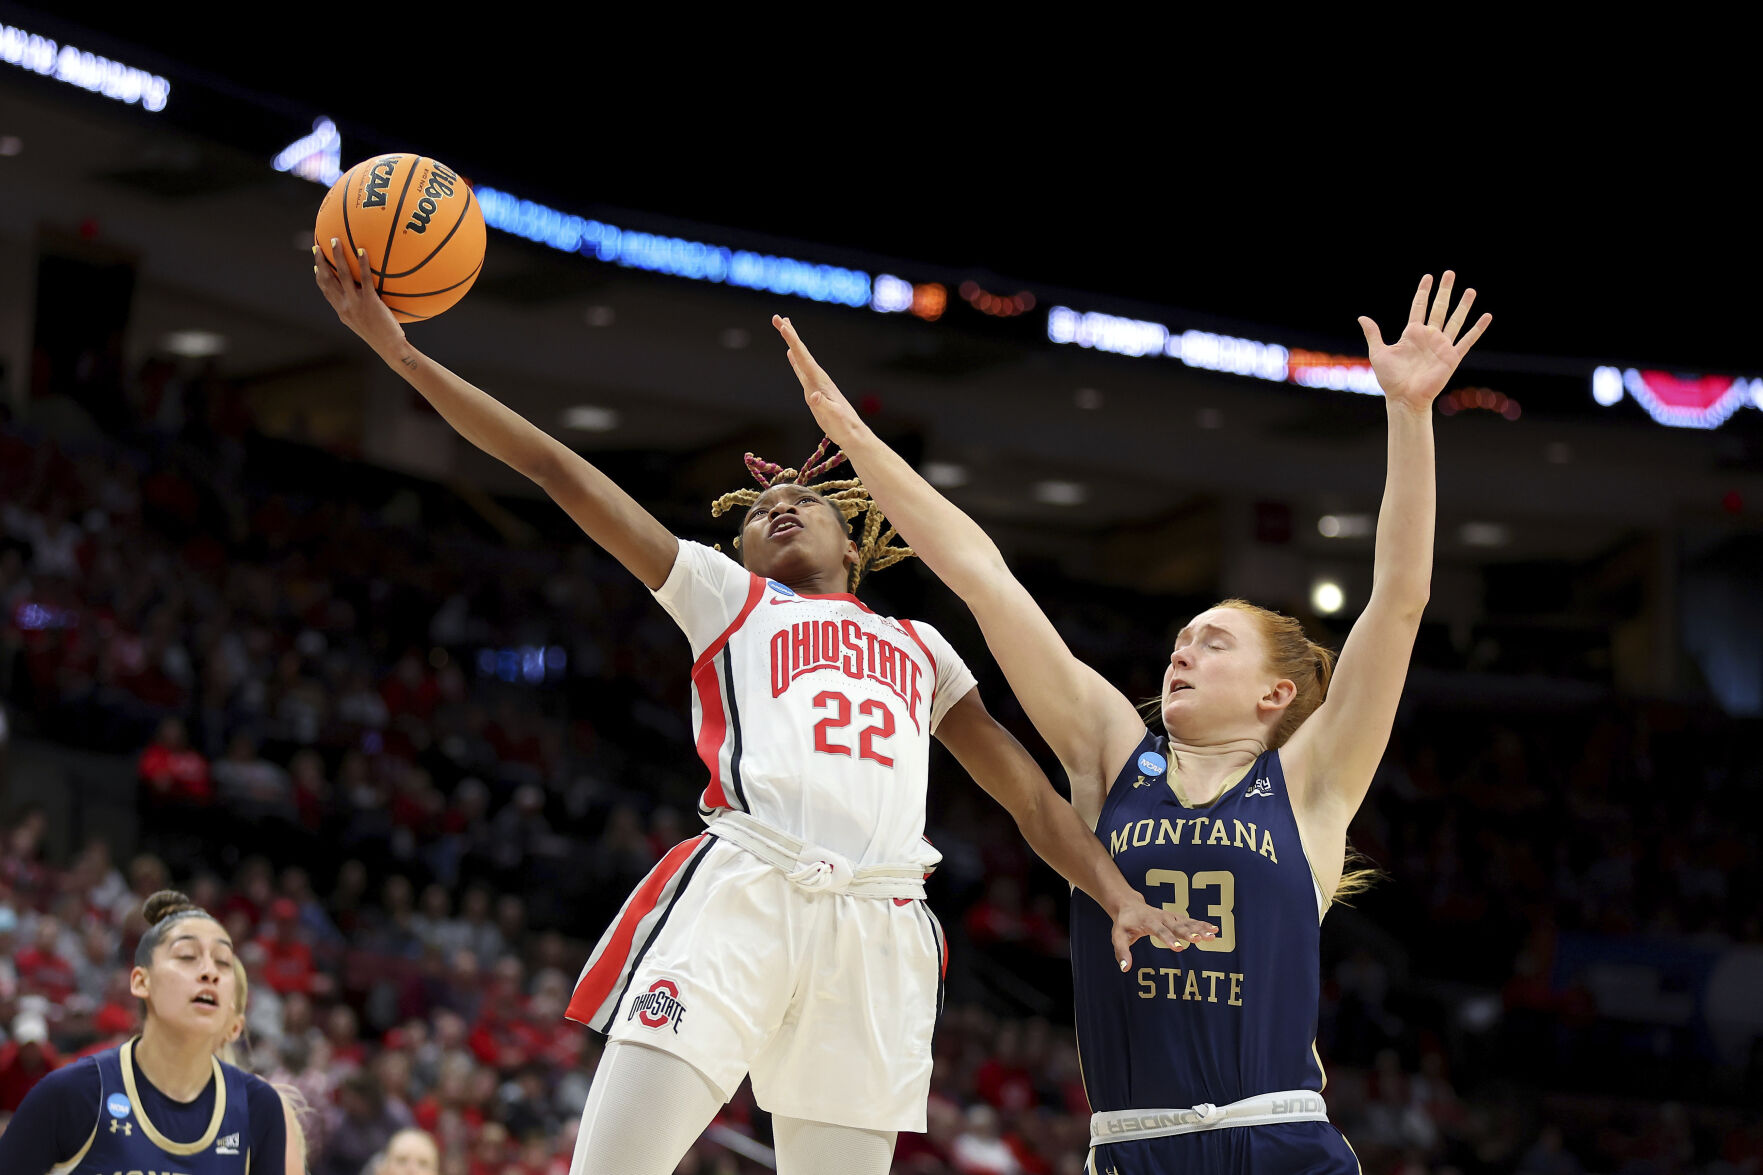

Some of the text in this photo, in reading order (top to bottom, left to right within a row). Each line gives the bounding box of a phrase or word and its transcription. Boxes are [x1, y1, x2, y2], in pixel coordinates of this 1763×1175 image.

[812, 690, 896, 769] 22
[1141, 758, 1163, 774] NCAA
[1110, 817, 1278, 864] MONTANA
[1146, 868, 1236, 953] 33
[1137, 967, 1244, 1006] STATE
